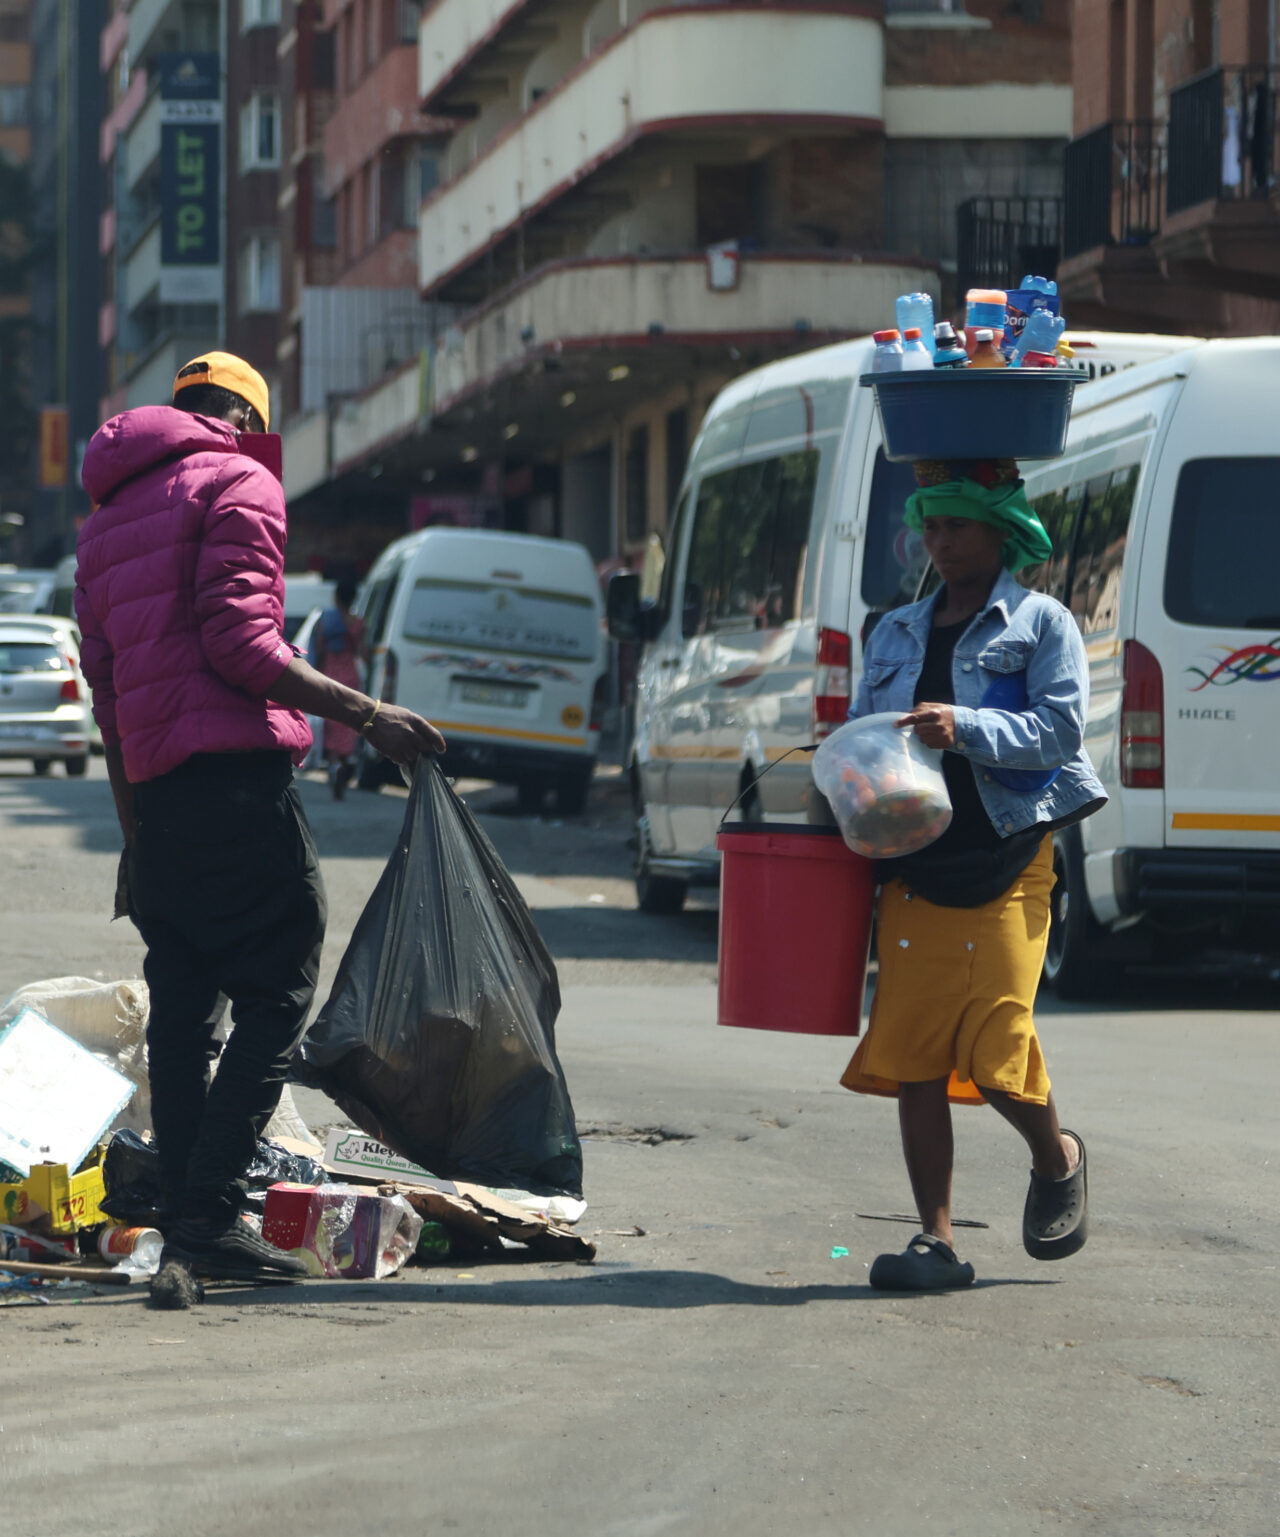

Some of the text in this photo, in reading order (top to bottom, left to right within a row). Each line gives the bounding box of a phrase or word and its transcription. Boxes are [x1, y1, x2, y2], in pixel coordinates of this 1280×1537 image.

[177, 131, 205, 196] LET
[177, 203, 205, 254] TO
[1178, 708, 1236, 721] HIACE
[361, 1153, 384, 1165] Quality
[385, 1158, 407, 1168] Queen
